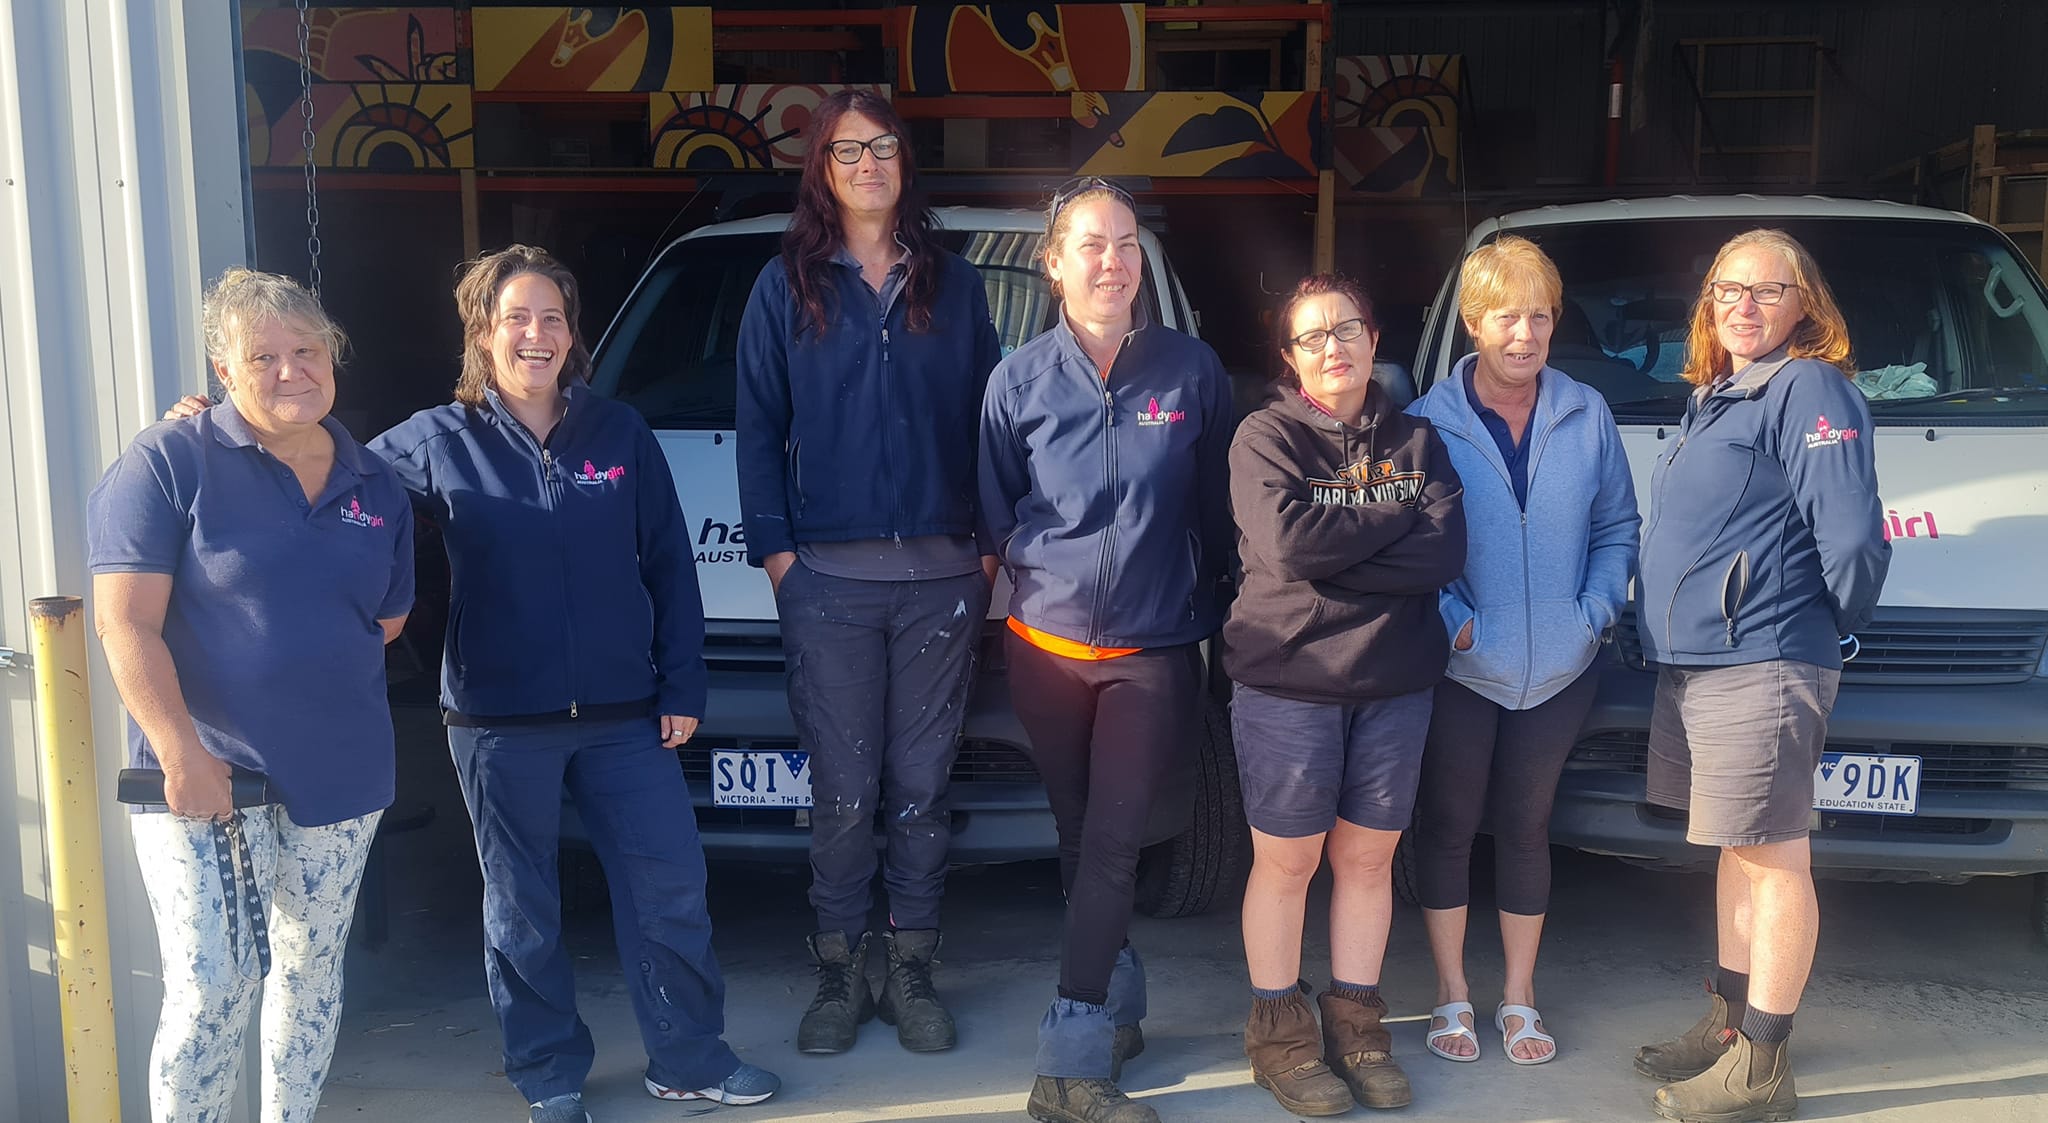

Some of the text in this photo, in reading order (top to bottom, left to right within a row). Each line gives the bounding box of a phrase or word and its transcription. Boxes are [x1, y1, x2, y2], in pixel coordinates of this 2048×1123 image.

[1137, 410, 1185, 423] handygirl
[1805, 428, 1858, 443] handygirl
[1808, 439, 1839, 449] AUSTRALIA
[573, 465, 625, 480] handygirl
[340, 505, 384, 527] handygirl
[695, 550, 748, 563] AUST
[1843, 763, 1912, 801] 9DK
[720, 795, 766, 804] VICTORIA
[781, 795, 800, 804] THE
[1820, 799, 1874, 809] EDUCATION
[1877, 802, 1906, 811] STATE
